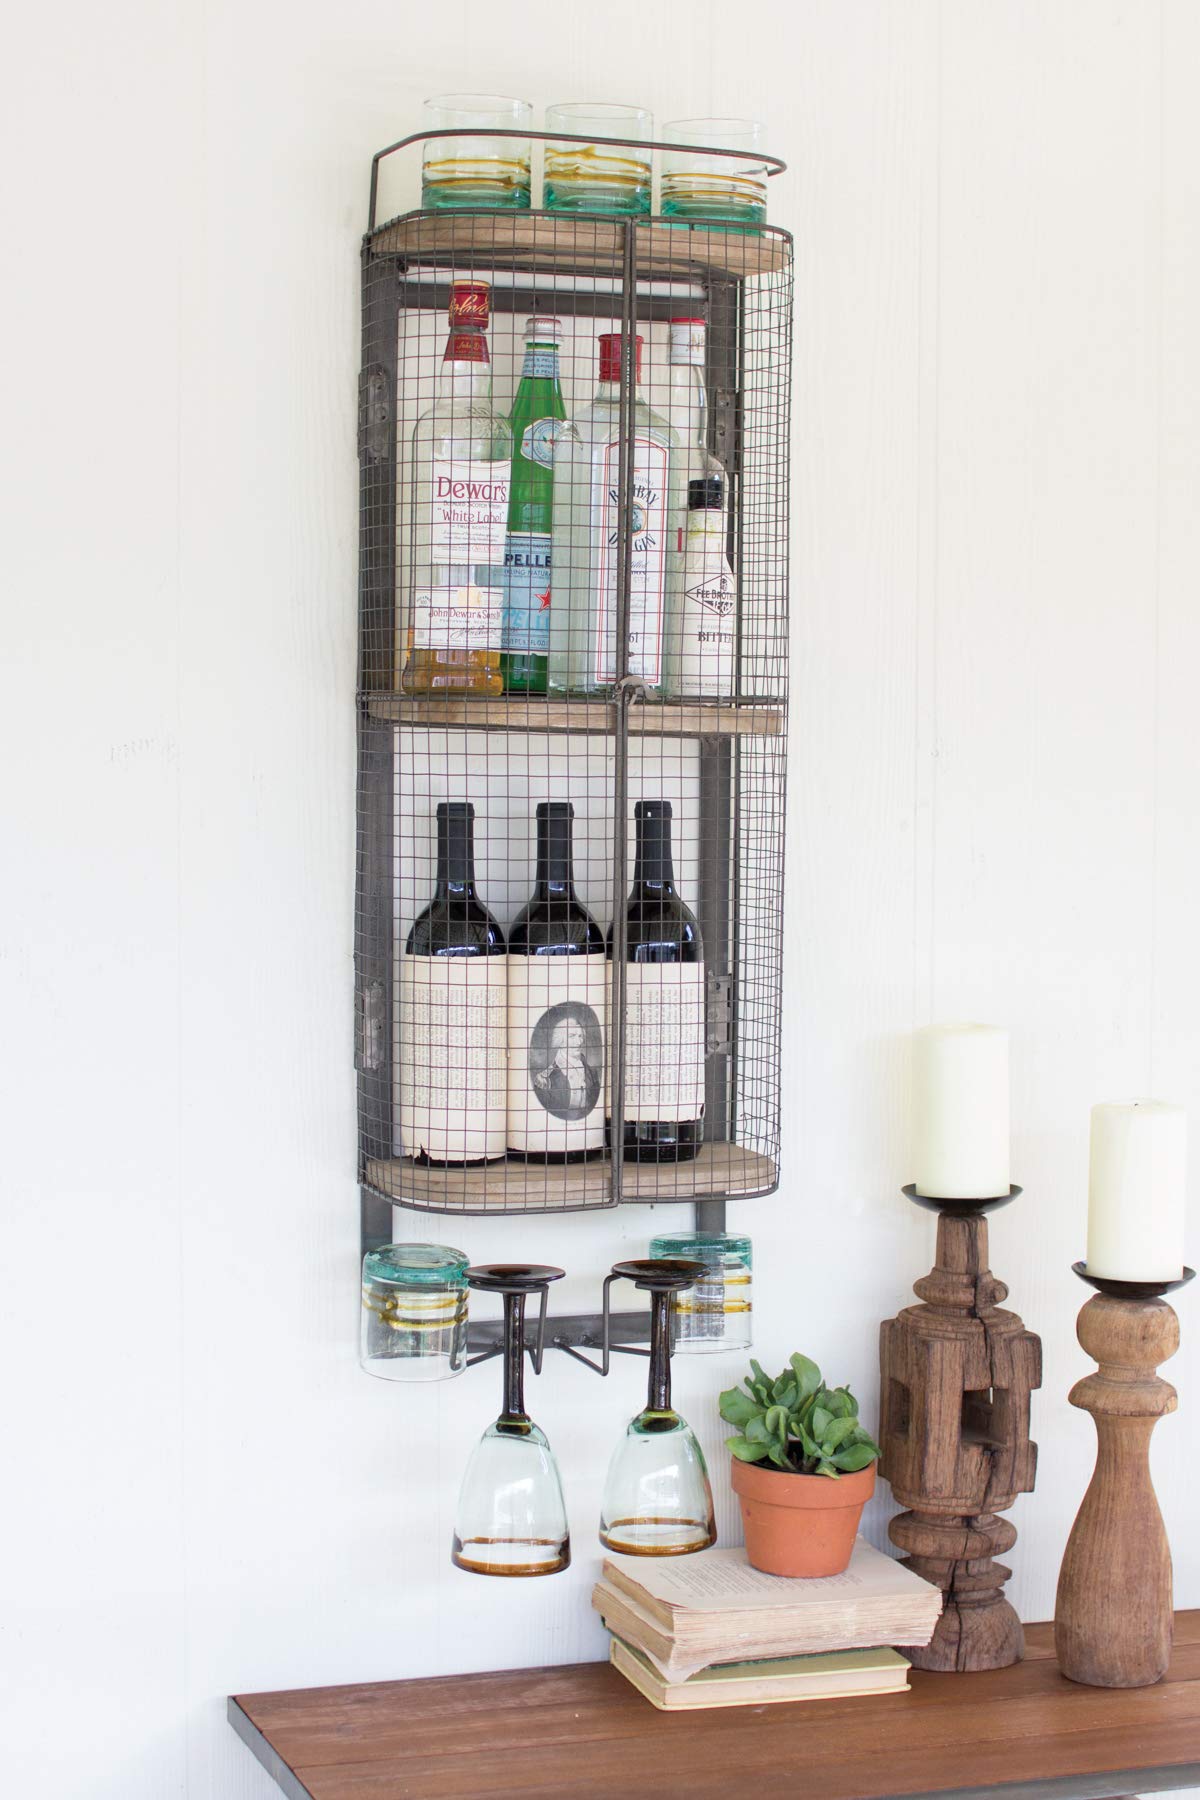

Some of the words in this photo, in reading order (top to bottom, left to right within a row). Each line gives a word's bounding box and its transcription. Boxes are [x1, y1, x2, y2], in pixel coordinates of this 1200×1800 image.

[437, 476, 507, 502] Dewar's
[634, 534, 656, 552] GIN
[696, 588, 710, 600] FEE
[448, 607, 477, 620] Dewar
